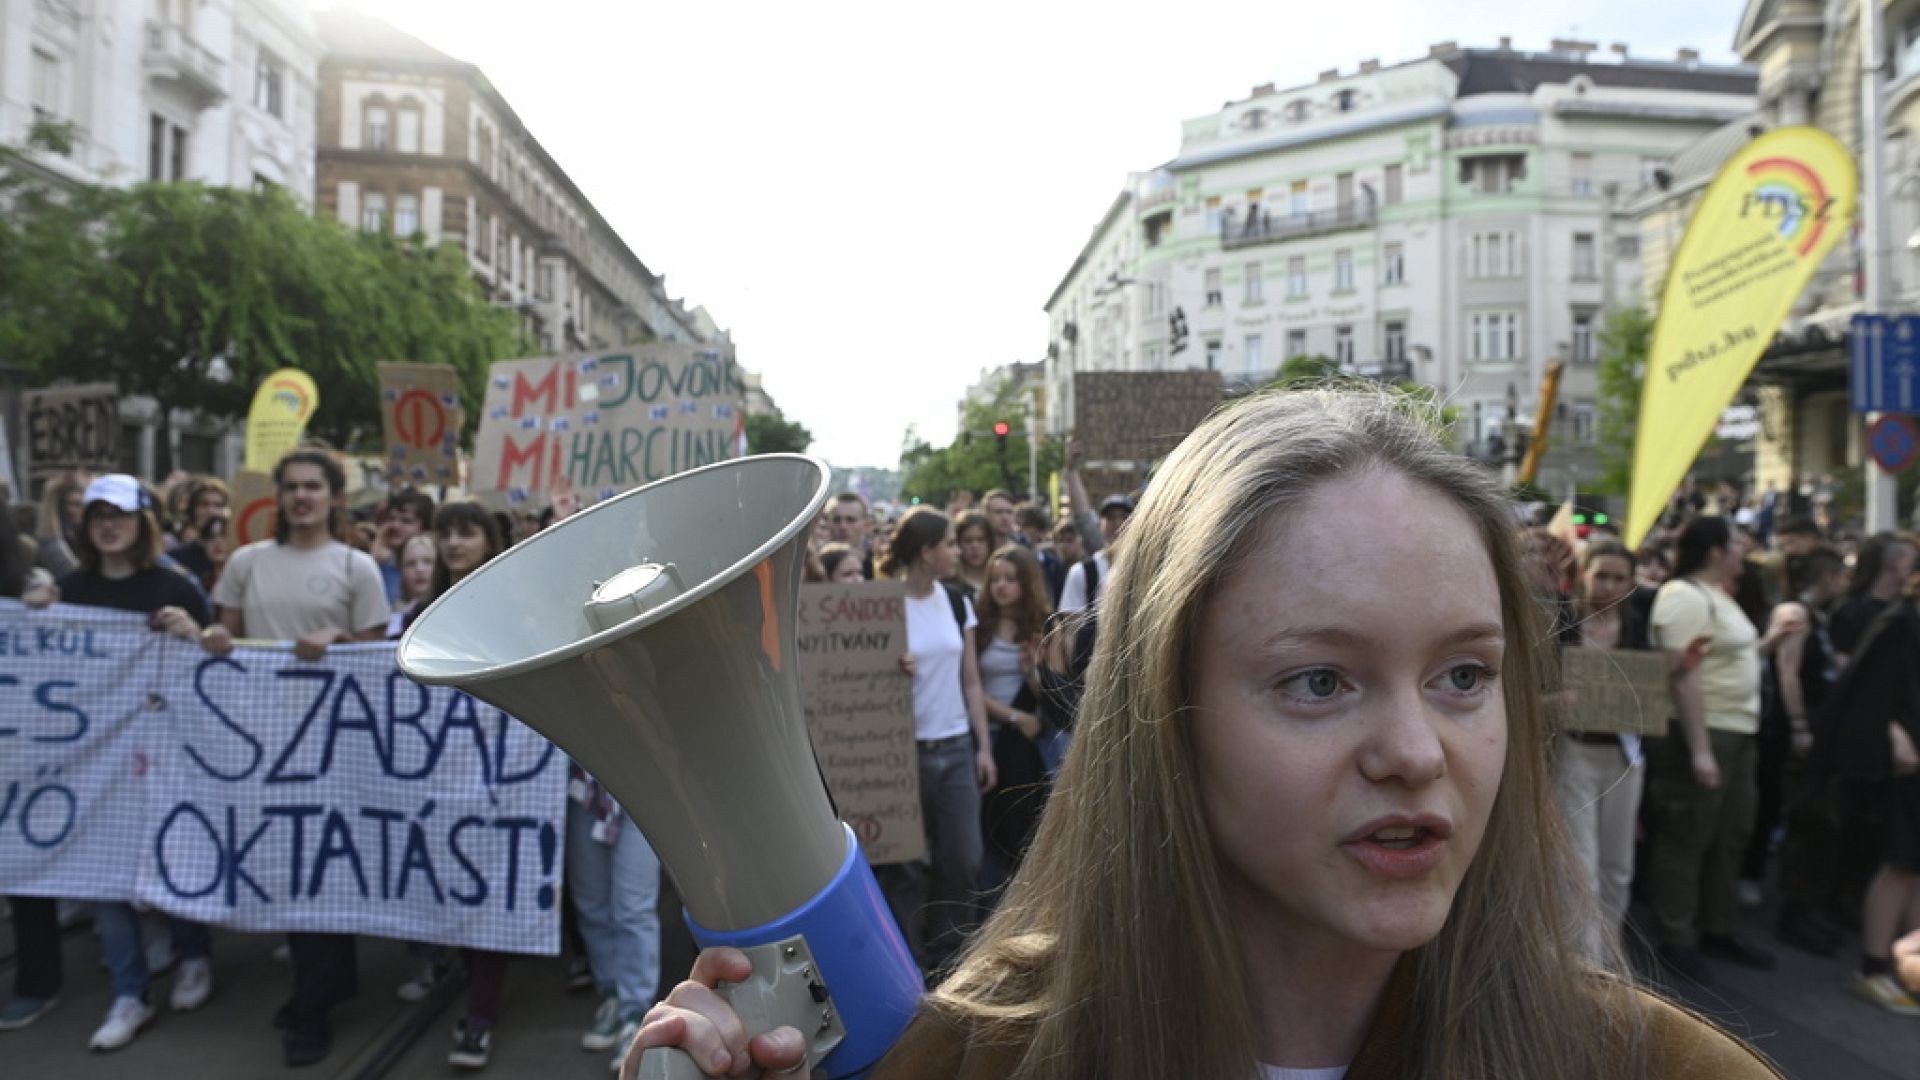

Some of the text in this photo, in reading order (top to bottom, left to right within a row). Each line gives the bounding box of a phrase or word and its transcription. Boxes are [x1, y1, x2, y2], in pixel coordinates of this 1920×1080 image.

[511, 362, 576, 419] MI
[496, 431, 562, 491] MI
[183, 657, 554, 805] SZABAD
[155, 800, 558, 911] OKTATÁST!
